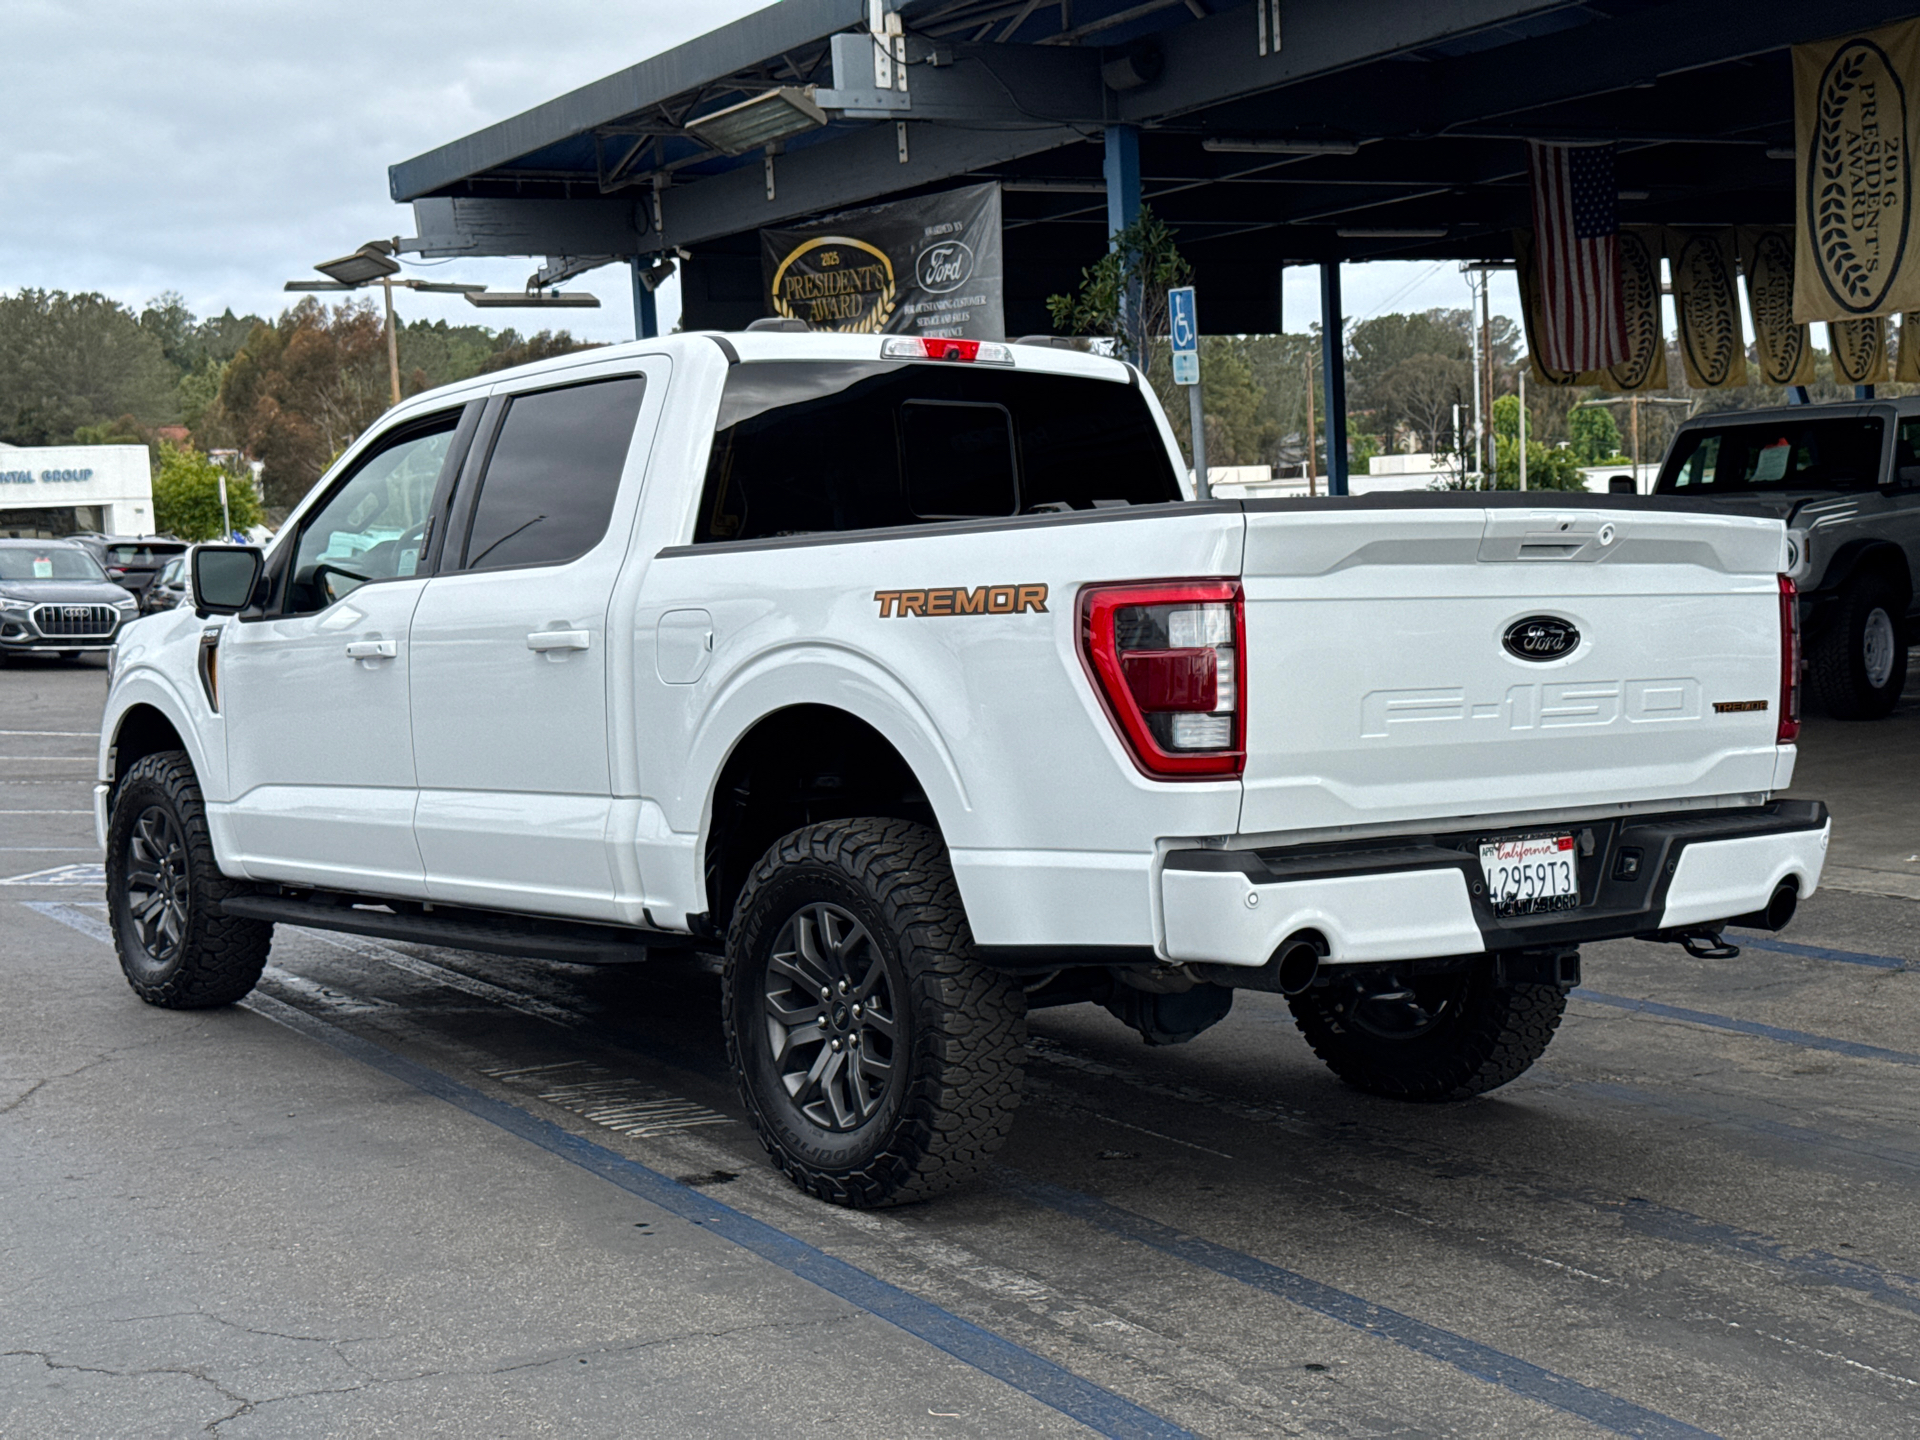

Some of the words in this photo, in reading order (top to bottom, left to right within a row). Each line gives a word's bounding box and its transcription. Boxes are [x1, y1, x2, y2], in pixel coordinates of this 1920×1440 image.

[1845, 128, 1866, 232] AWARD
[1859, 80, 1881, 274] PRESIDENT'S
[1883, 137, 1900, 208] 2016
[820, 250, 840, 267] 2025
[925, 247, 963, 285] Ford
[784, 263, 884, 300] PRESIDENT'S
[809, 293, 863, 323] AWARD
[1756, 286, 1767, 325] 2020
[41, 469, 93, 483] GROUP
[873, 583, 1050, 618] TREMOR
[1523, 625, 1566, 651] Ford
[1360, 677, 1702, 737] F-150
[1712, 700, 1768, 713] TREMOR
[1482, 847, 1494, 857] APR
[1497, 841, 1557, 863] California
